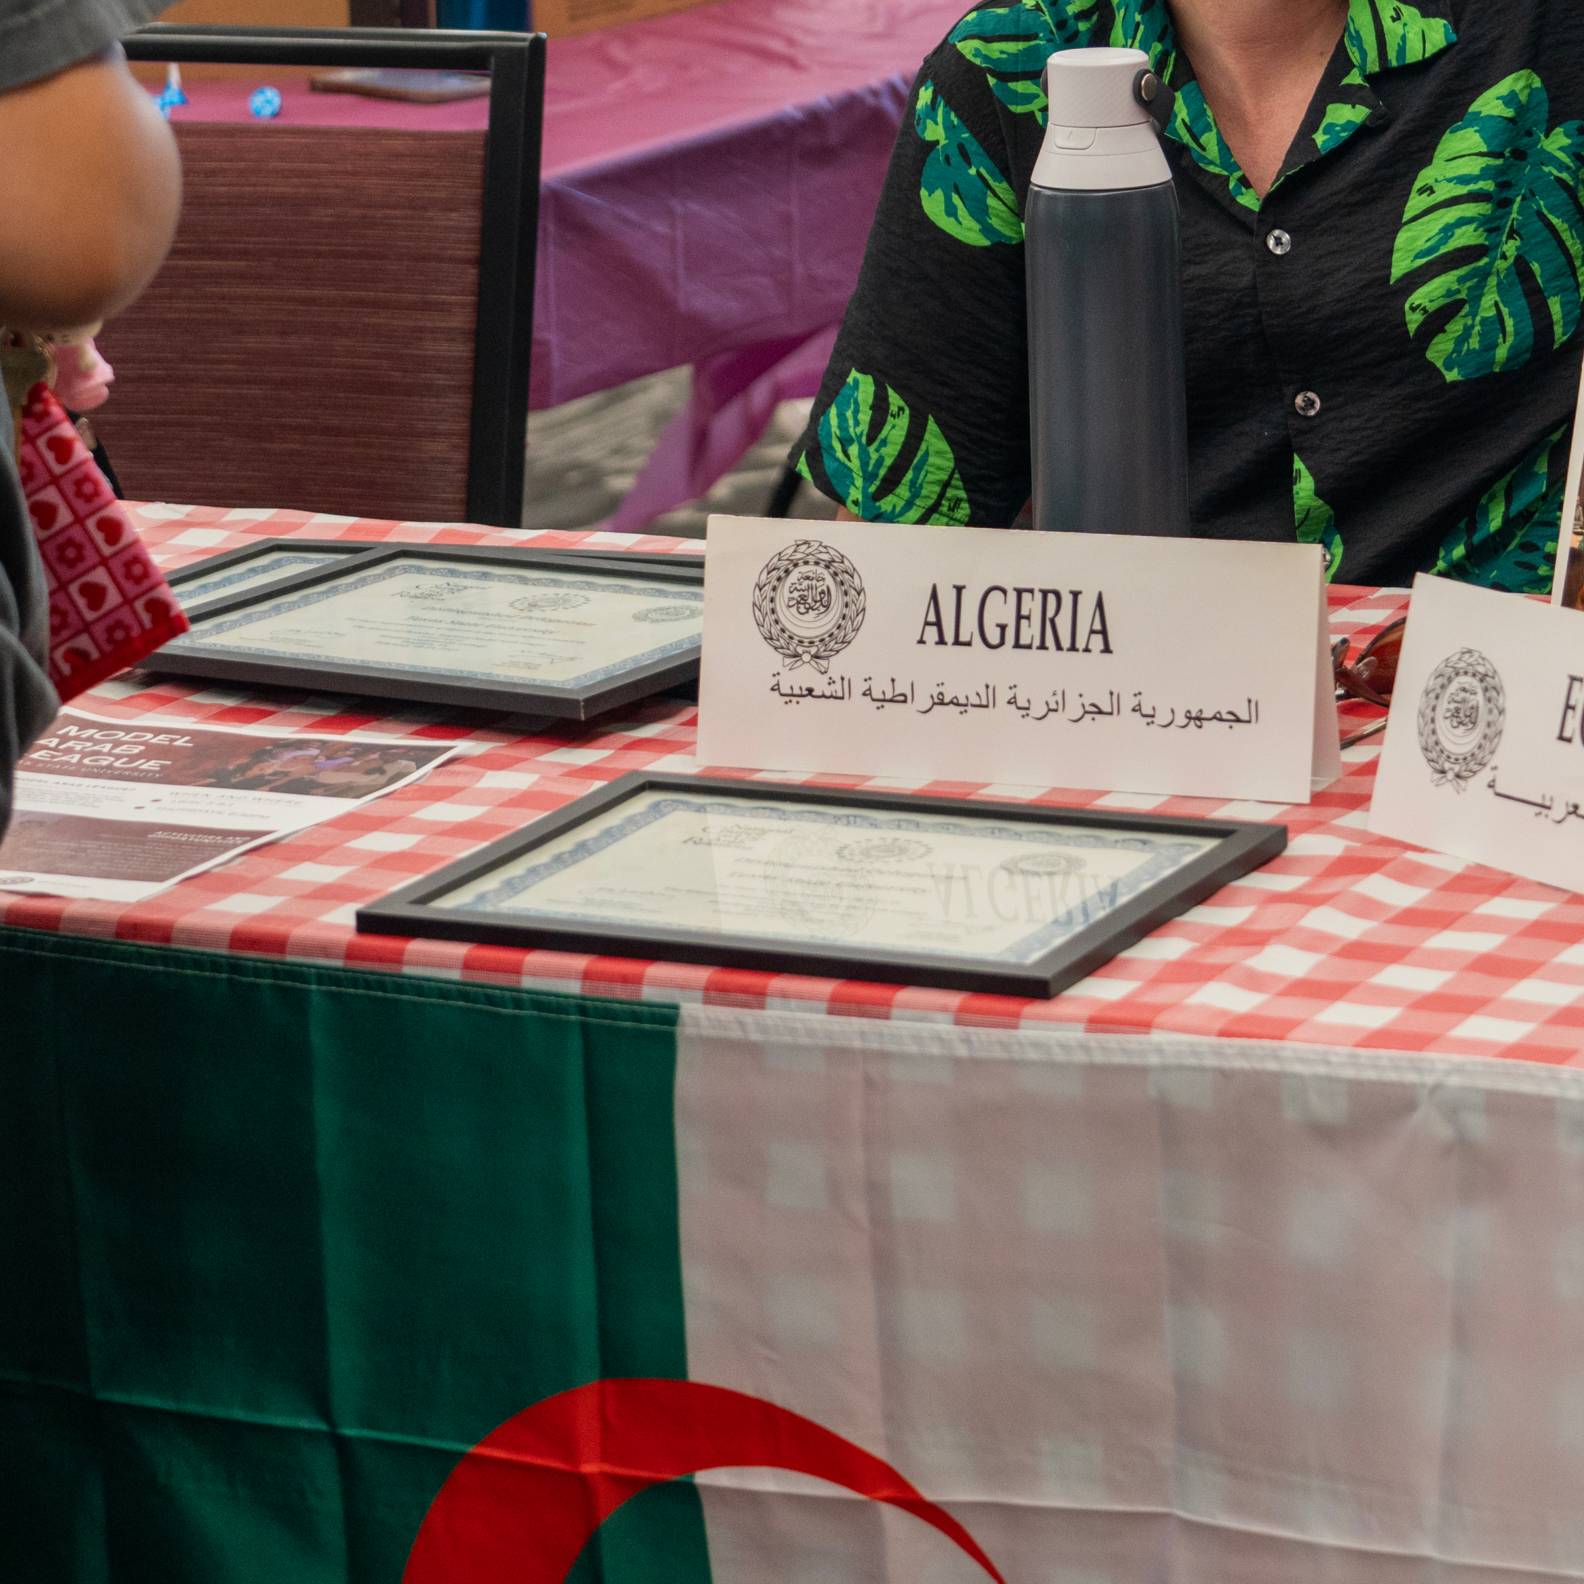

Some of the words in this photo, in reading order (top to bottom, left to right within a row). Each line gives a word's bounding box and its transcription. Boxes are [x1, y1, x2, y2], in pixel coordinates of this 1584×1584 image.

[916, 583, 1113, 654] ALGERIA
[769, 671, 852, 706] الشعبية
[862, 675, 997, 716] الديمقراطية
[1006, 683, 1121, 724] الجزائرية
[1130, 691, 1259, 730] الجمهورية
[33, 737, 146, 754] ARAB
[57, 725, 194, 747] MODEL
[29, 749, 172, 771] EAGUE
